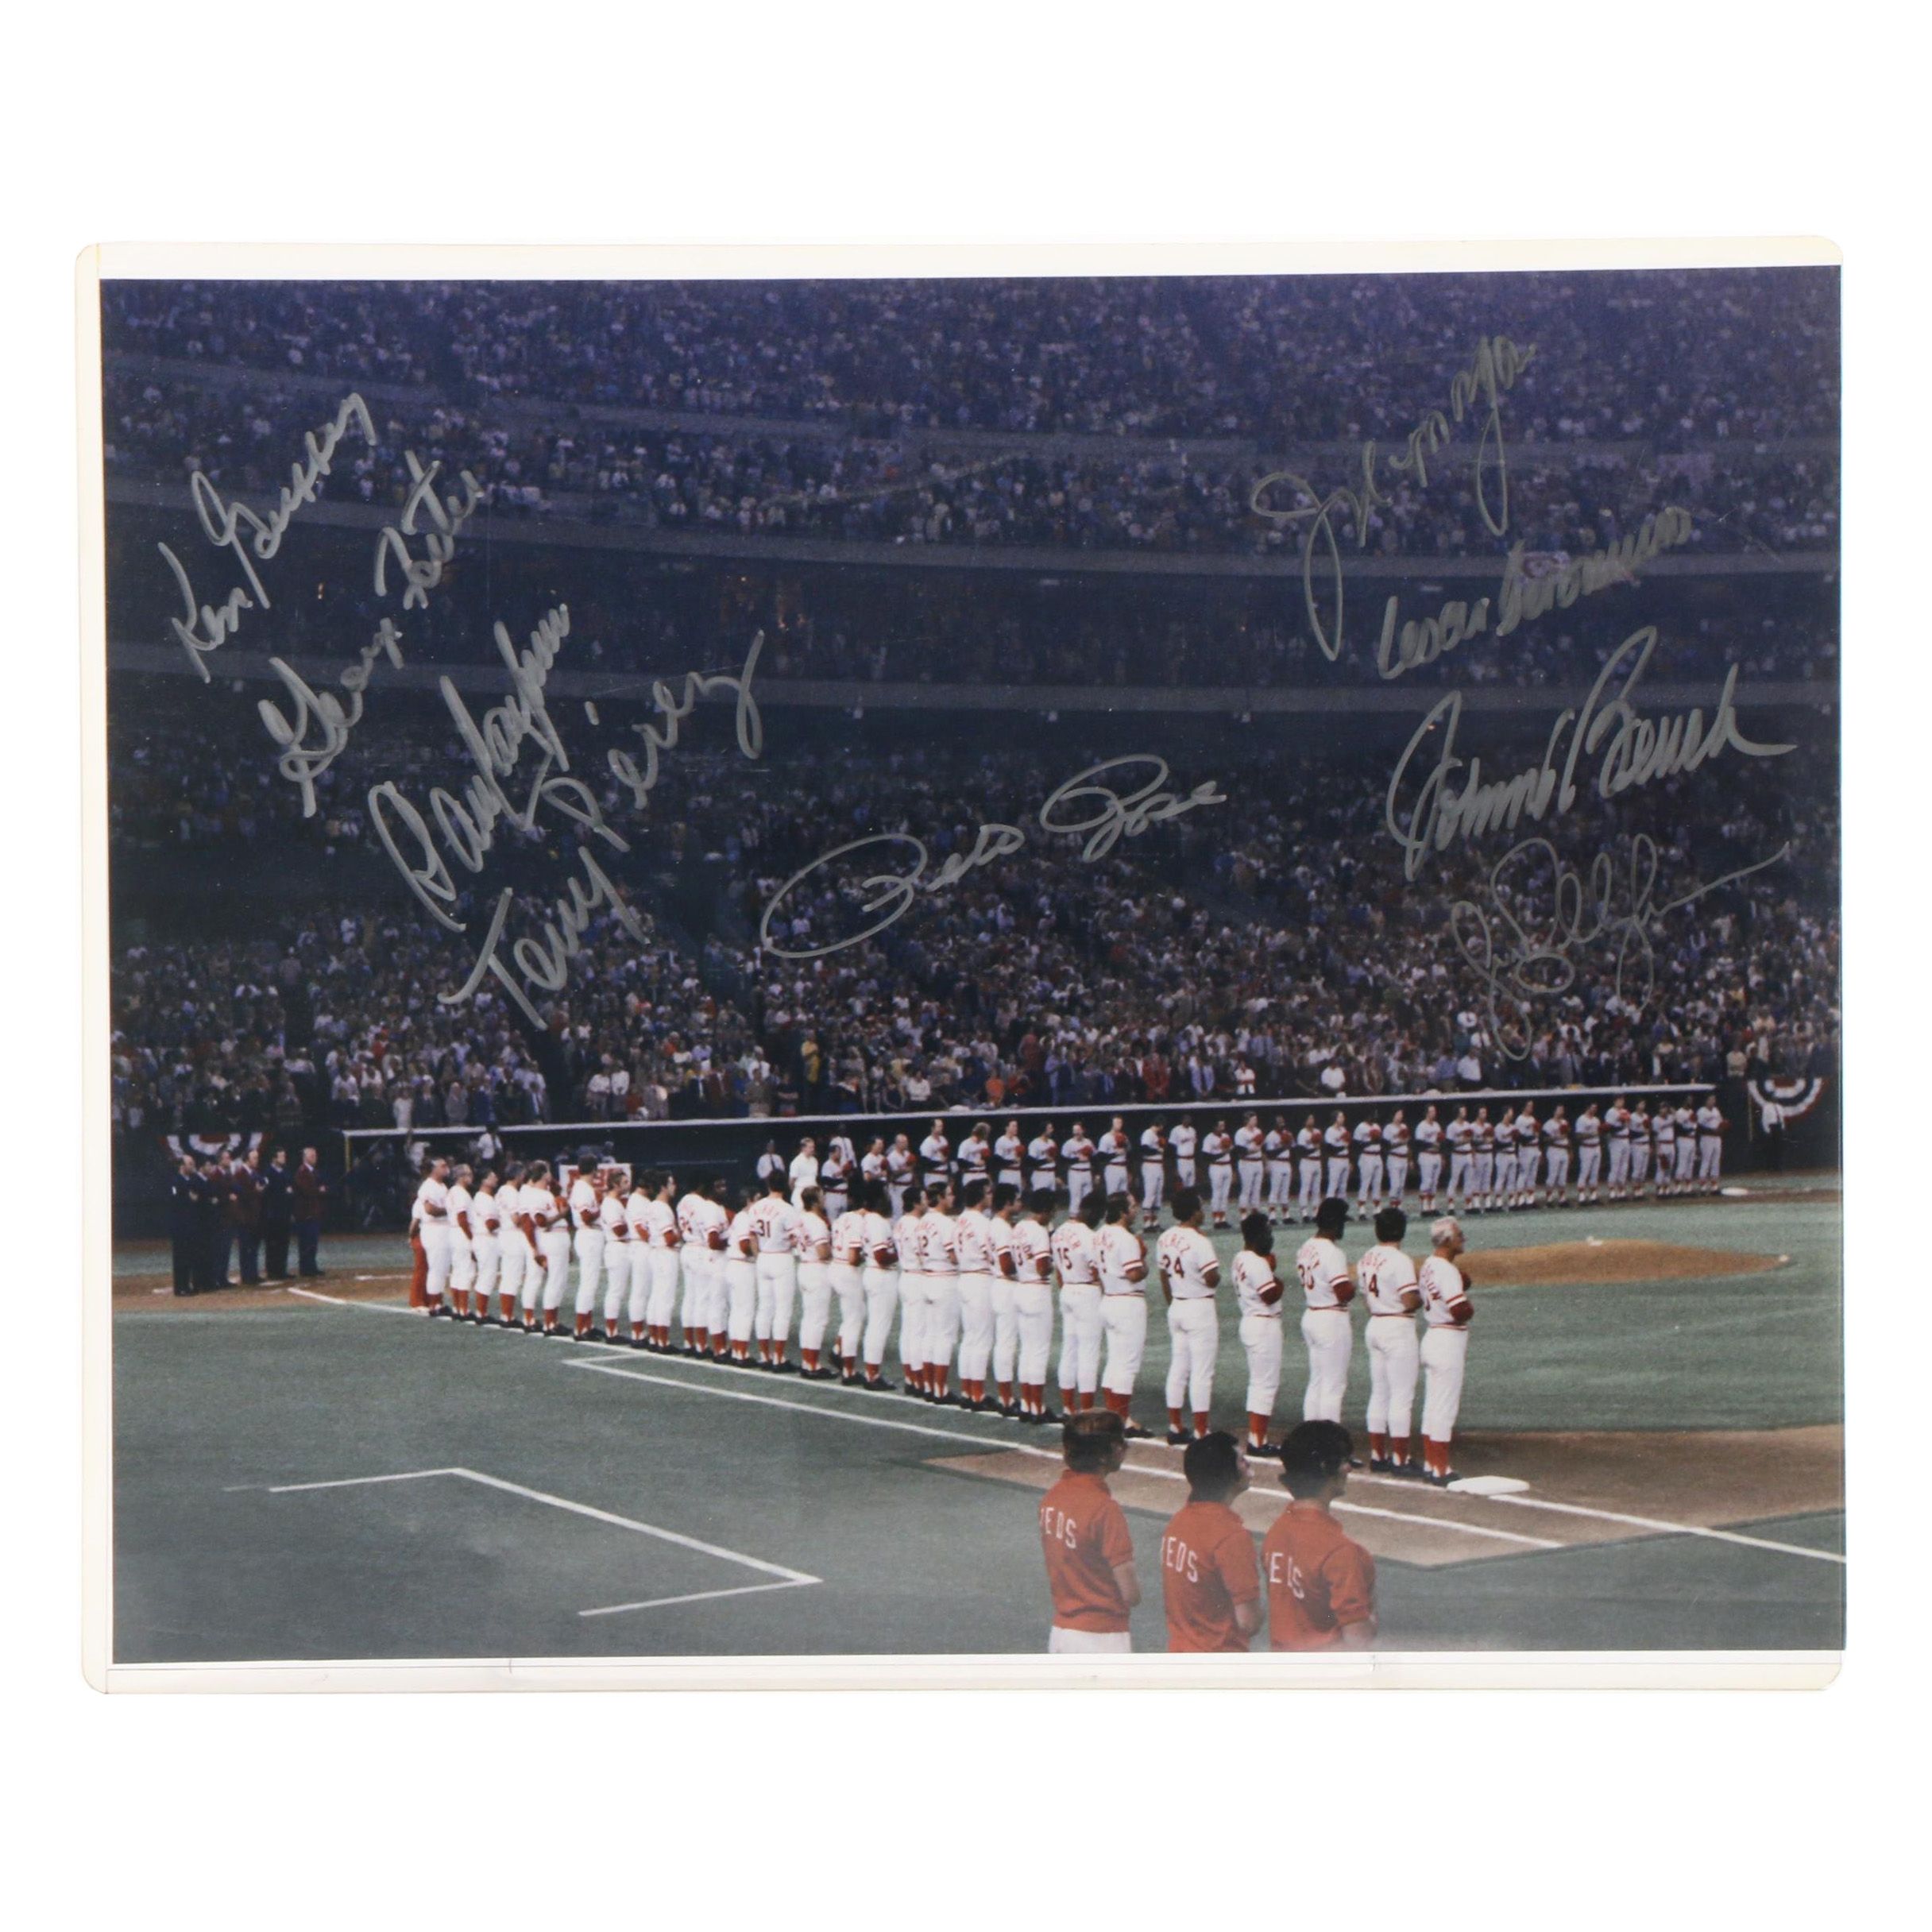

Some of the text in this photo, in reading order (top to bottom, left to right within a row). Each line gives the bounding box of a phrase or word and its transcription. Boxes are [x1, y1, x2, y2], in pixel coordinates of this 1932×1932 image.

[756, 1219, 771, 1238] 31
[1161, 1254, 1185, 1279] 24
[1161, 1536, 1199, 1583] EDS
